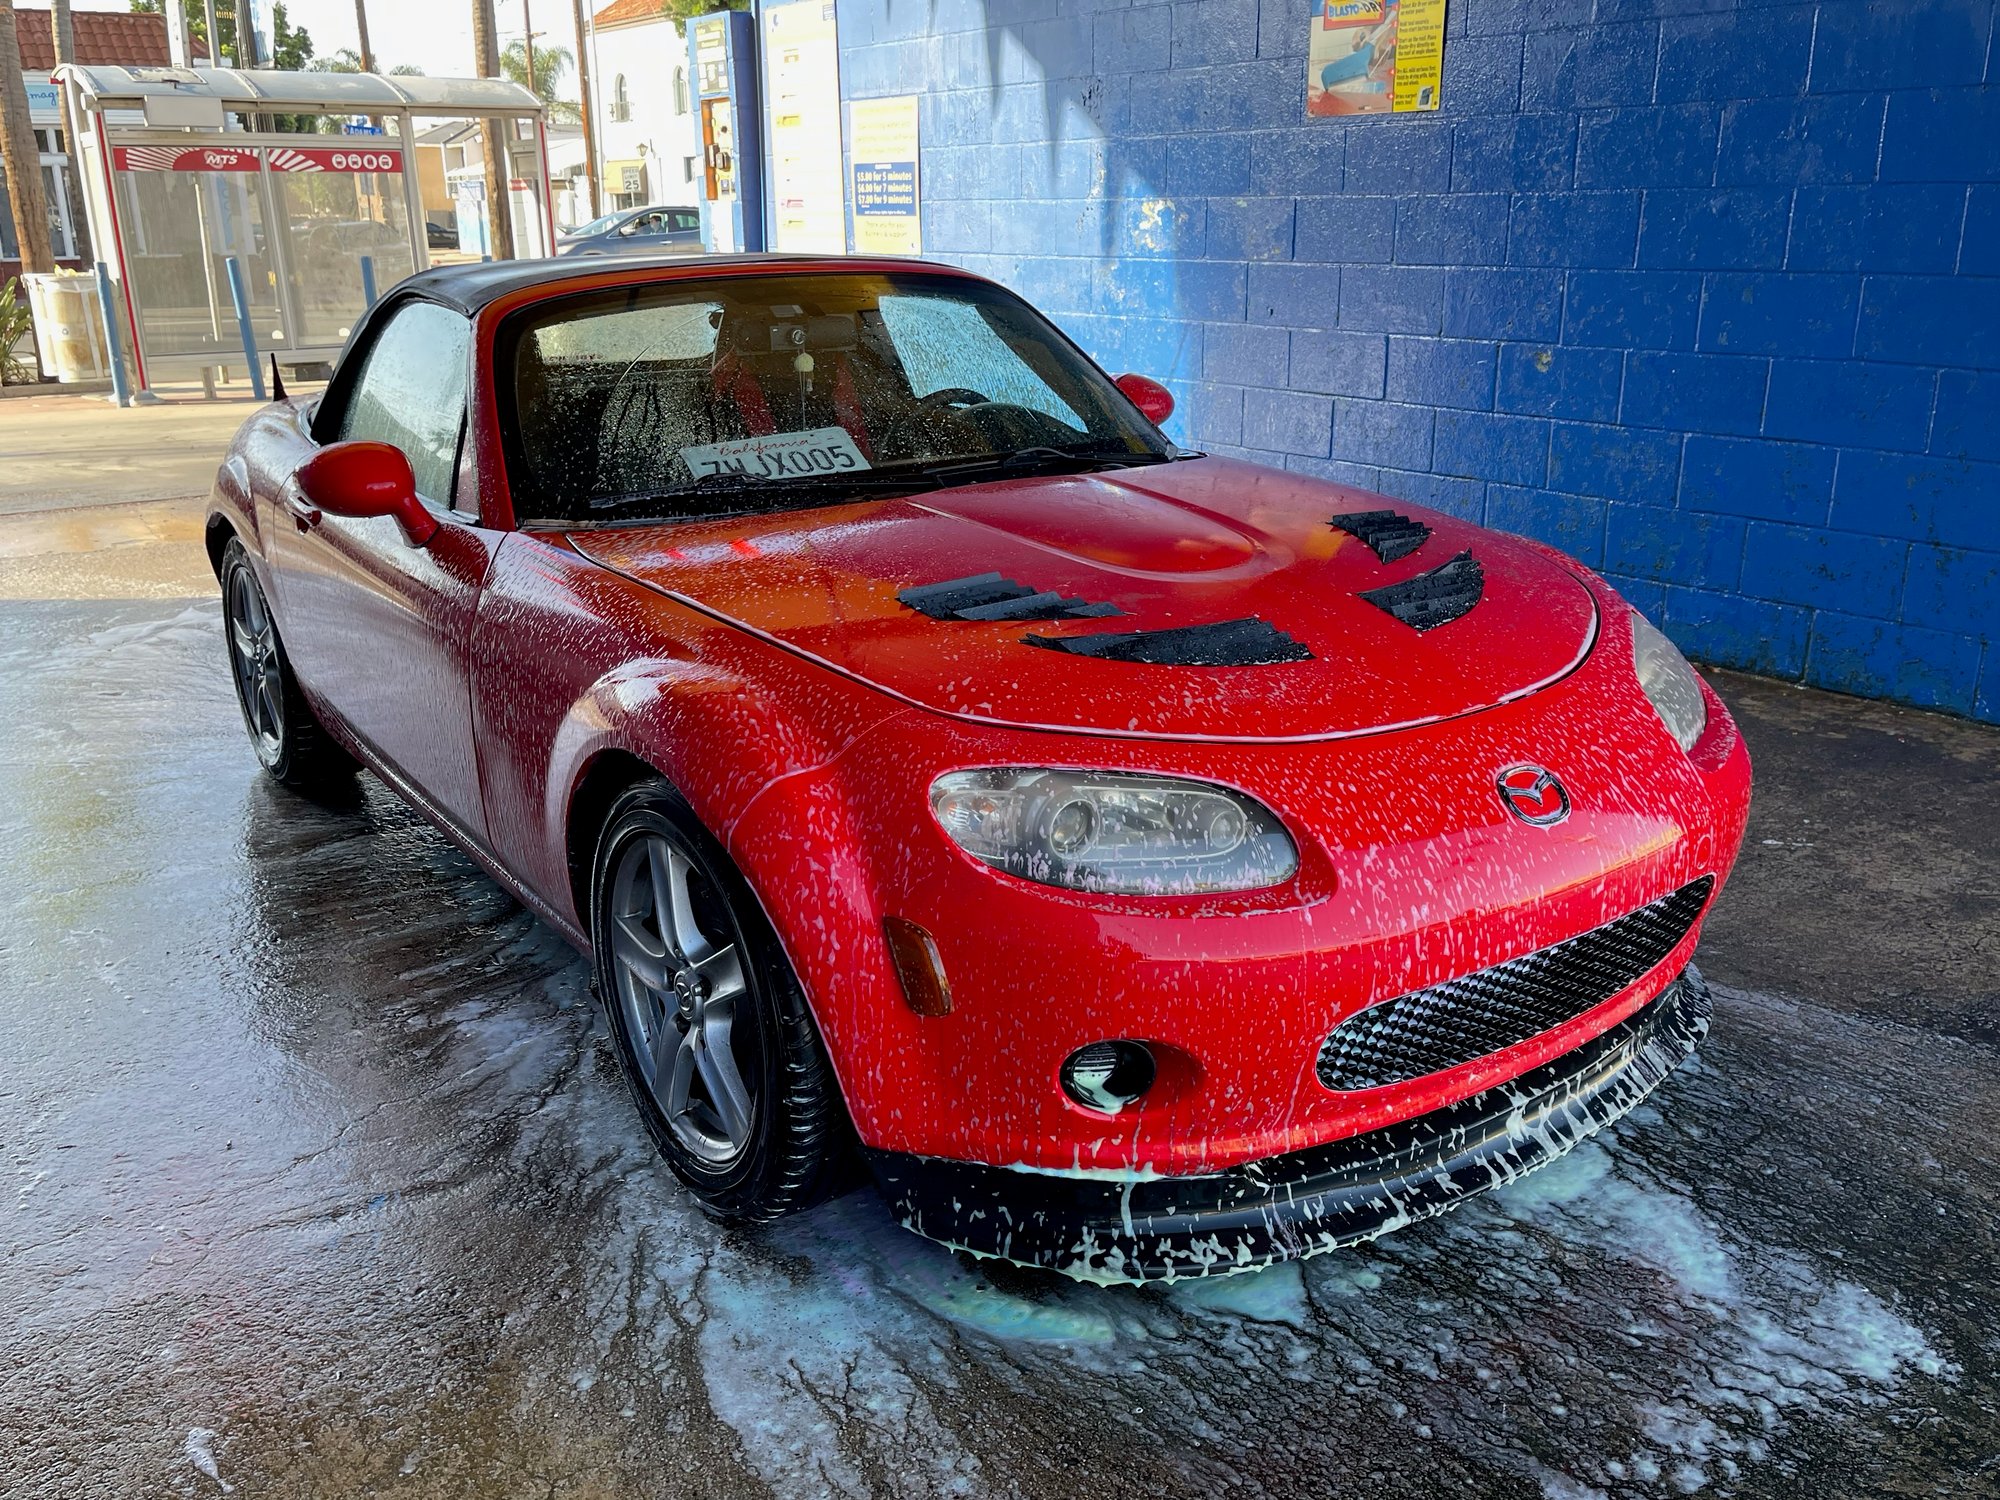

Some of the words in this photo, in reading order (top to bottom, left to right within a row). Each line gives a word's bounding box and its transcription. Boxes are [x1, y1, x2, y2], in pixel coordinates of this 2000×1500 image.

[349, 126, 373, 136] ADAMS
[206, 153, 238, 166] MTS
[873, 171, 882, 181] for
[882, 171, 887, 181] 5
[887, 171, 912, 181] minutes
[625, 180, 639, 190] 25
[873, 182, 882, 192] for
[882, 183, 887, 193] 7
[887, 182, 912, 193] minutes
[873, 194, 882, 204] for
[883, 194, 887, 204] 9
[887, 194, 913, 204] minutes
[719, 439, 810, 456] California
[701, 445, 857, 478] 7WJX005
